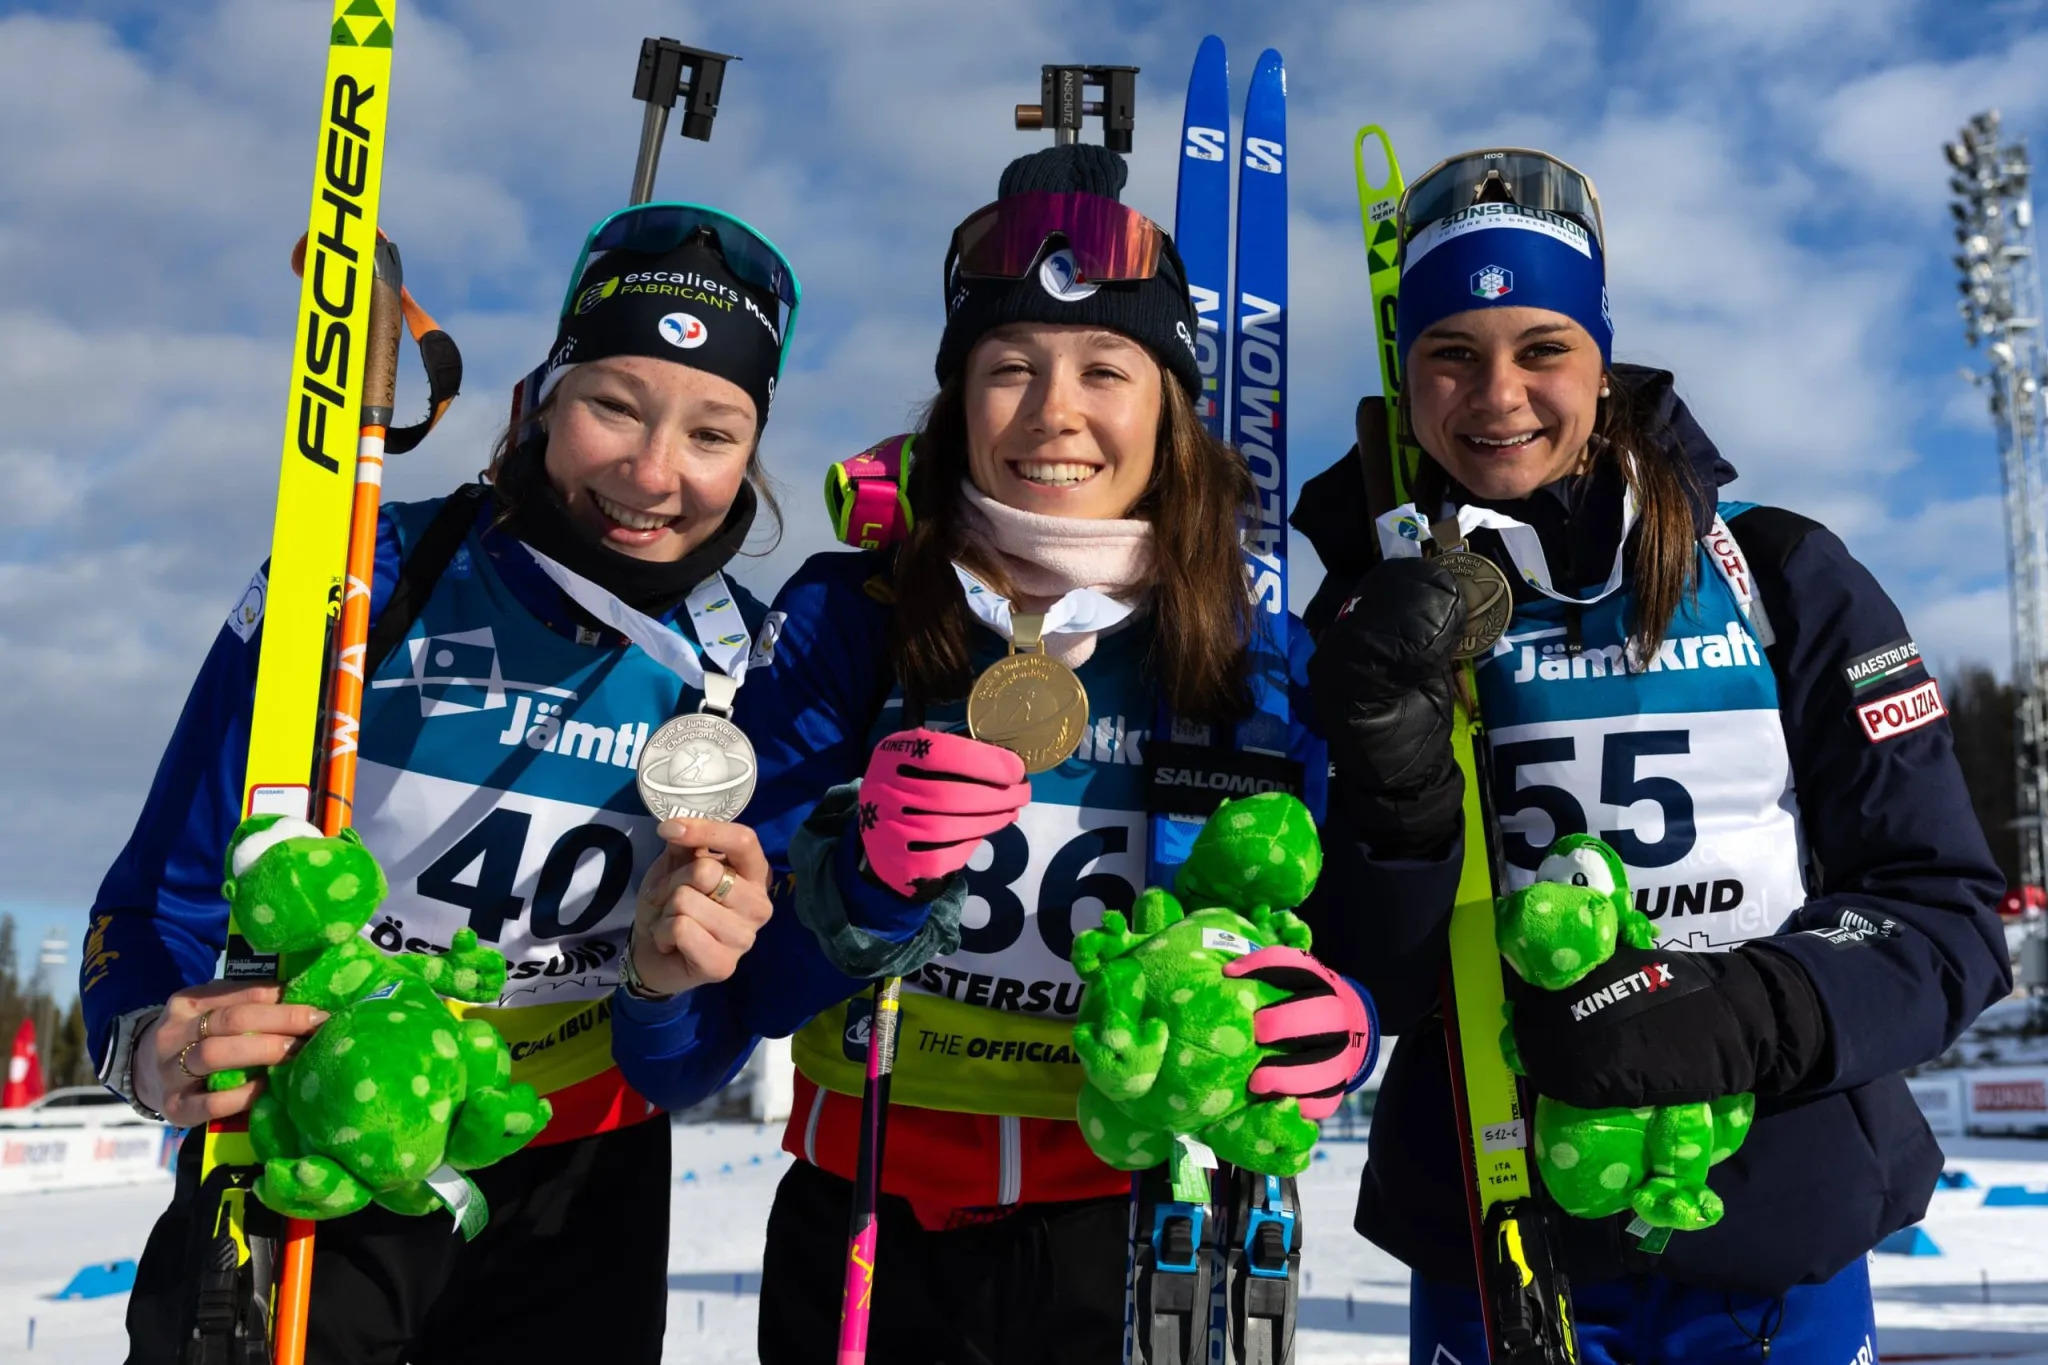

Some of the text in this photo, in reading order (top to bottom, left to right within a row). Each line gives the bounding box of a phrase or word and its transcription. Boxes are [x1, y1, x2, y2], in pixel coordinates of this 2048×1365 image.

[1371, 205, 1396, 221] TEAM
[1372, 200, 1389, 212] ITA
[298, 73, 376, 475] FISCHER
[625, 270, 739, 302] escaliers
[1479, 267, 1505, 277] FISI
[620, 283, 735, 313] FABRICANT
[1240, 292, 1282, 614] SALOMON
[1846, 647, 1902, 681] MAESTRI
[1898, 644, 1910, 660] DI
[1864, 689, 1940, 734] POLIZIA
[653, 720, 741, 749] Youth & Junior World
[666, 731, 729, 752] Championships
[1490, 730, 1697, 870] 55
[417, 807, 633, 943] 40
[959, 822, 1138, 963] 86
[1570, 962, 1675, 1022] KINETIXX
[558, 1008, 594, 1042] IBU
[919, 1030, 963, 1055] THE
[1488, 1173, 1518, 1186] TEAM
[1494, 1161, 1511, 1172] ITA
